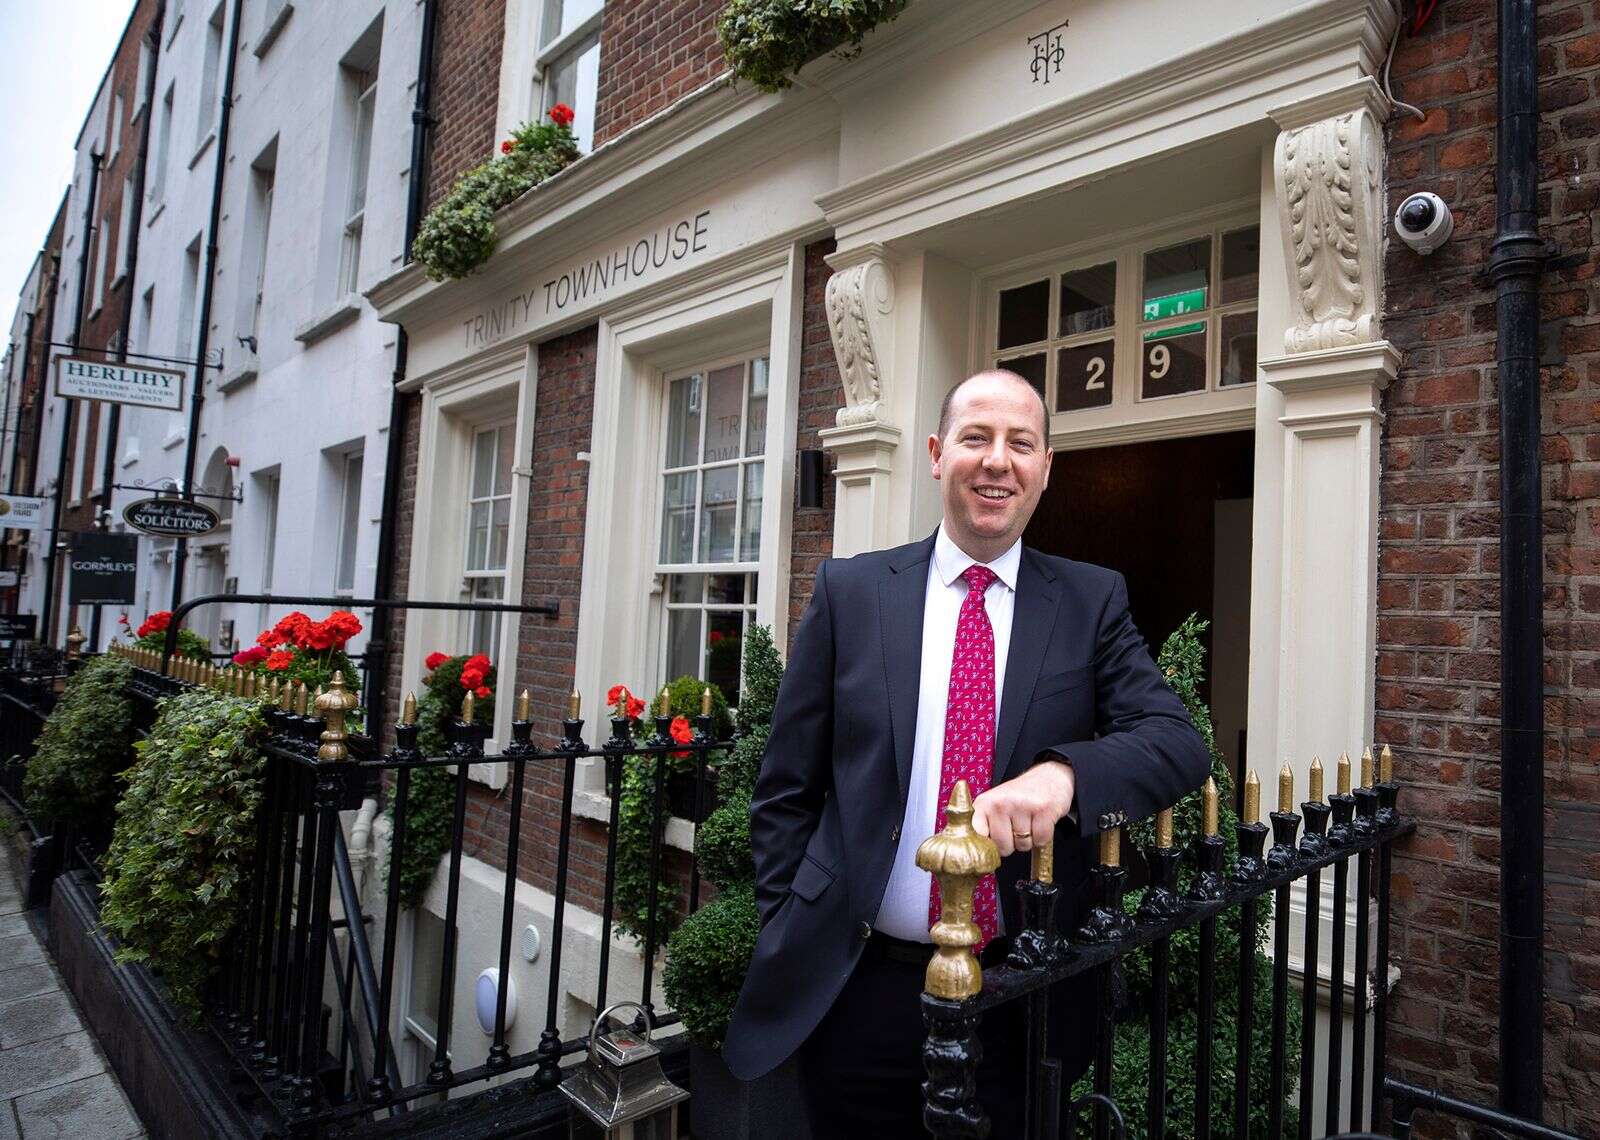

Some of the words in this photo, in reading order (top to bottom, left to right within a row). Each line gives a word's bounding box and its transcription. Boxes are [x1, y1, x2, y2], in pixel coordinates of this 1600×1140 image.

[464, 290, 535, 348] TRINITY
[543, 210, 711, 314] TOWNHOUSE
[67, 362, 174, 388] HERLIHY
[1085, 356, 1106, 391] 2
[1149, 344, 1171, 379] 9
[134, 513, 212, 530] SOLICITORS
[72, 561, 136, 572] GORMLEYS
